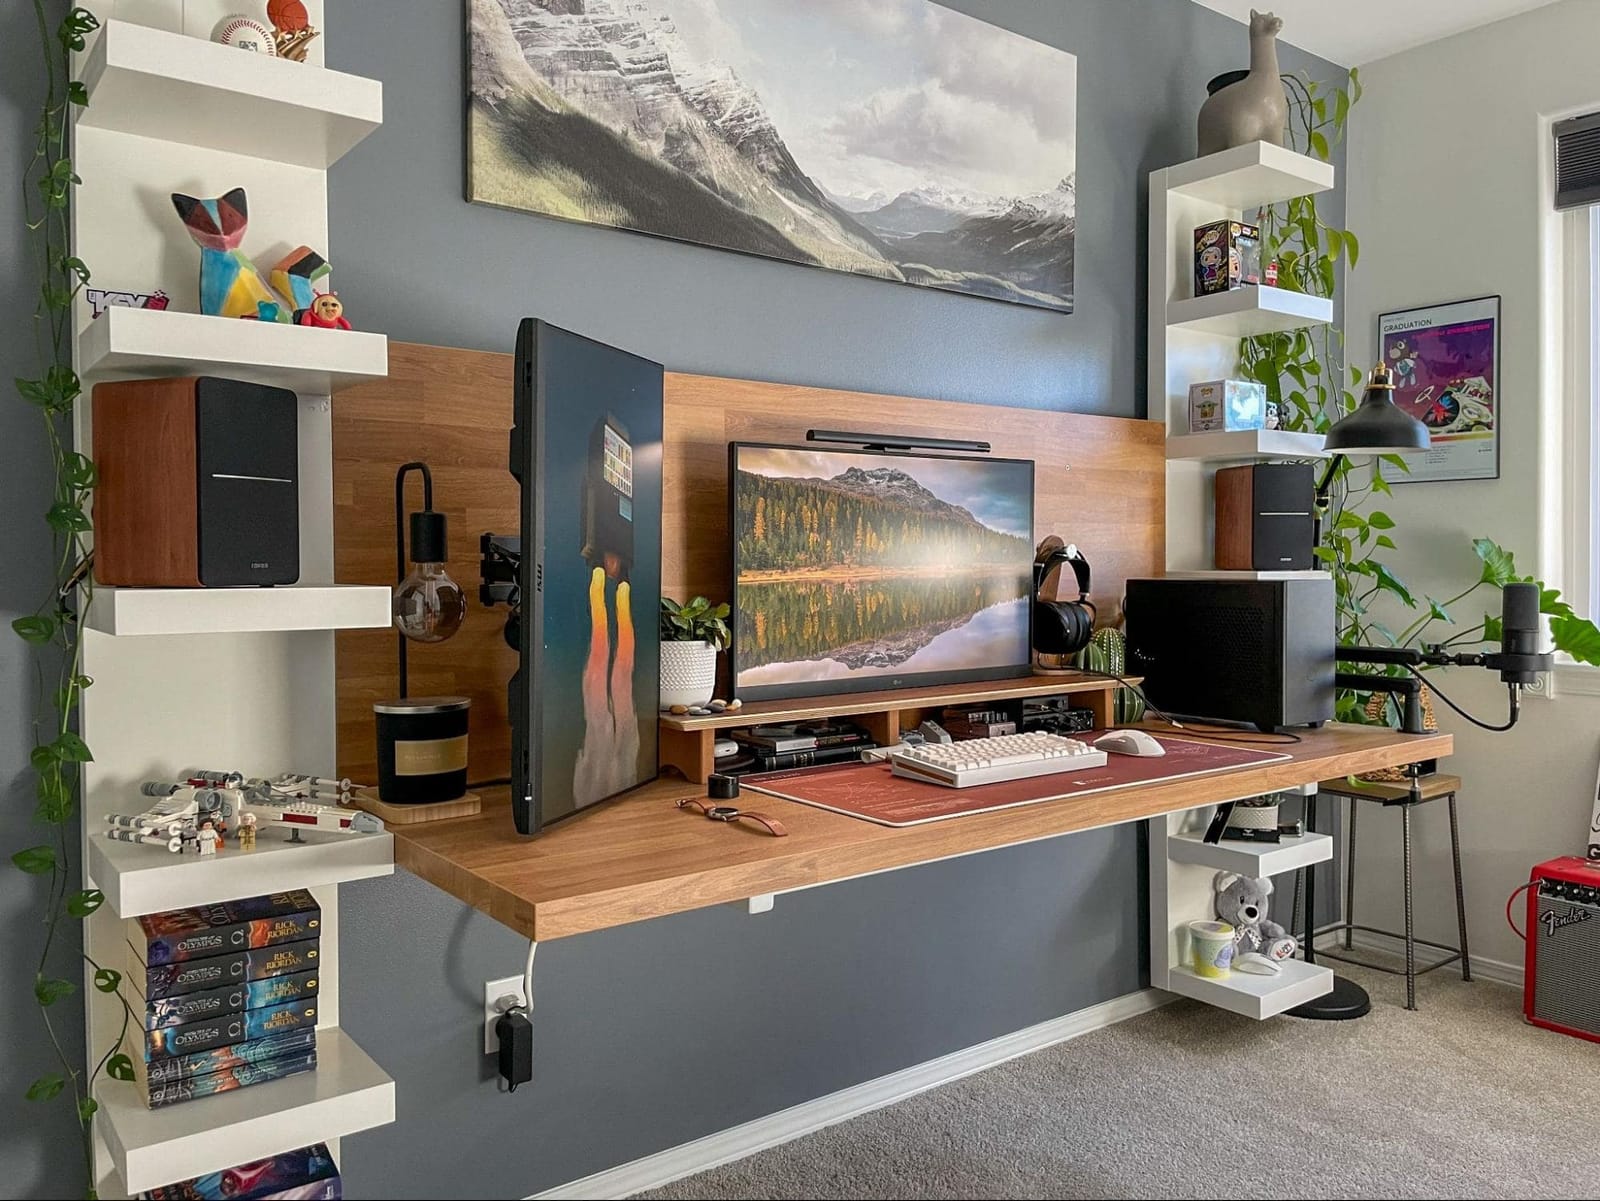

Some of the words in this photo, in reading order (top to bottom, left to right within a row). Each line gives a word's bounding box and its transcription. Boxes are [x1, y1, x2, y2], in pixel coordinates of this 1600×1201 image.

[1384, 319, 1432, 332] GRADUATION
[275, 920, 296, 931] RICK
[1541, 907, 1592, 936] Fender
[267, 926, 304, 939] RIORDAN
[177, 935, 223, 951] OLYMPUS
[273, 950, 295, 962] RICK
[266, 957, 302, 970] RIORDAN
[177, 966, 222, 983] OLYMPUS
[273, 980, 294, 992] RICK
[264, 988, 302, 1001] RIORDAN
[271, 1010, 292, 1021] RICK
[175, 1028, 219, 1045] OLYMPUS
